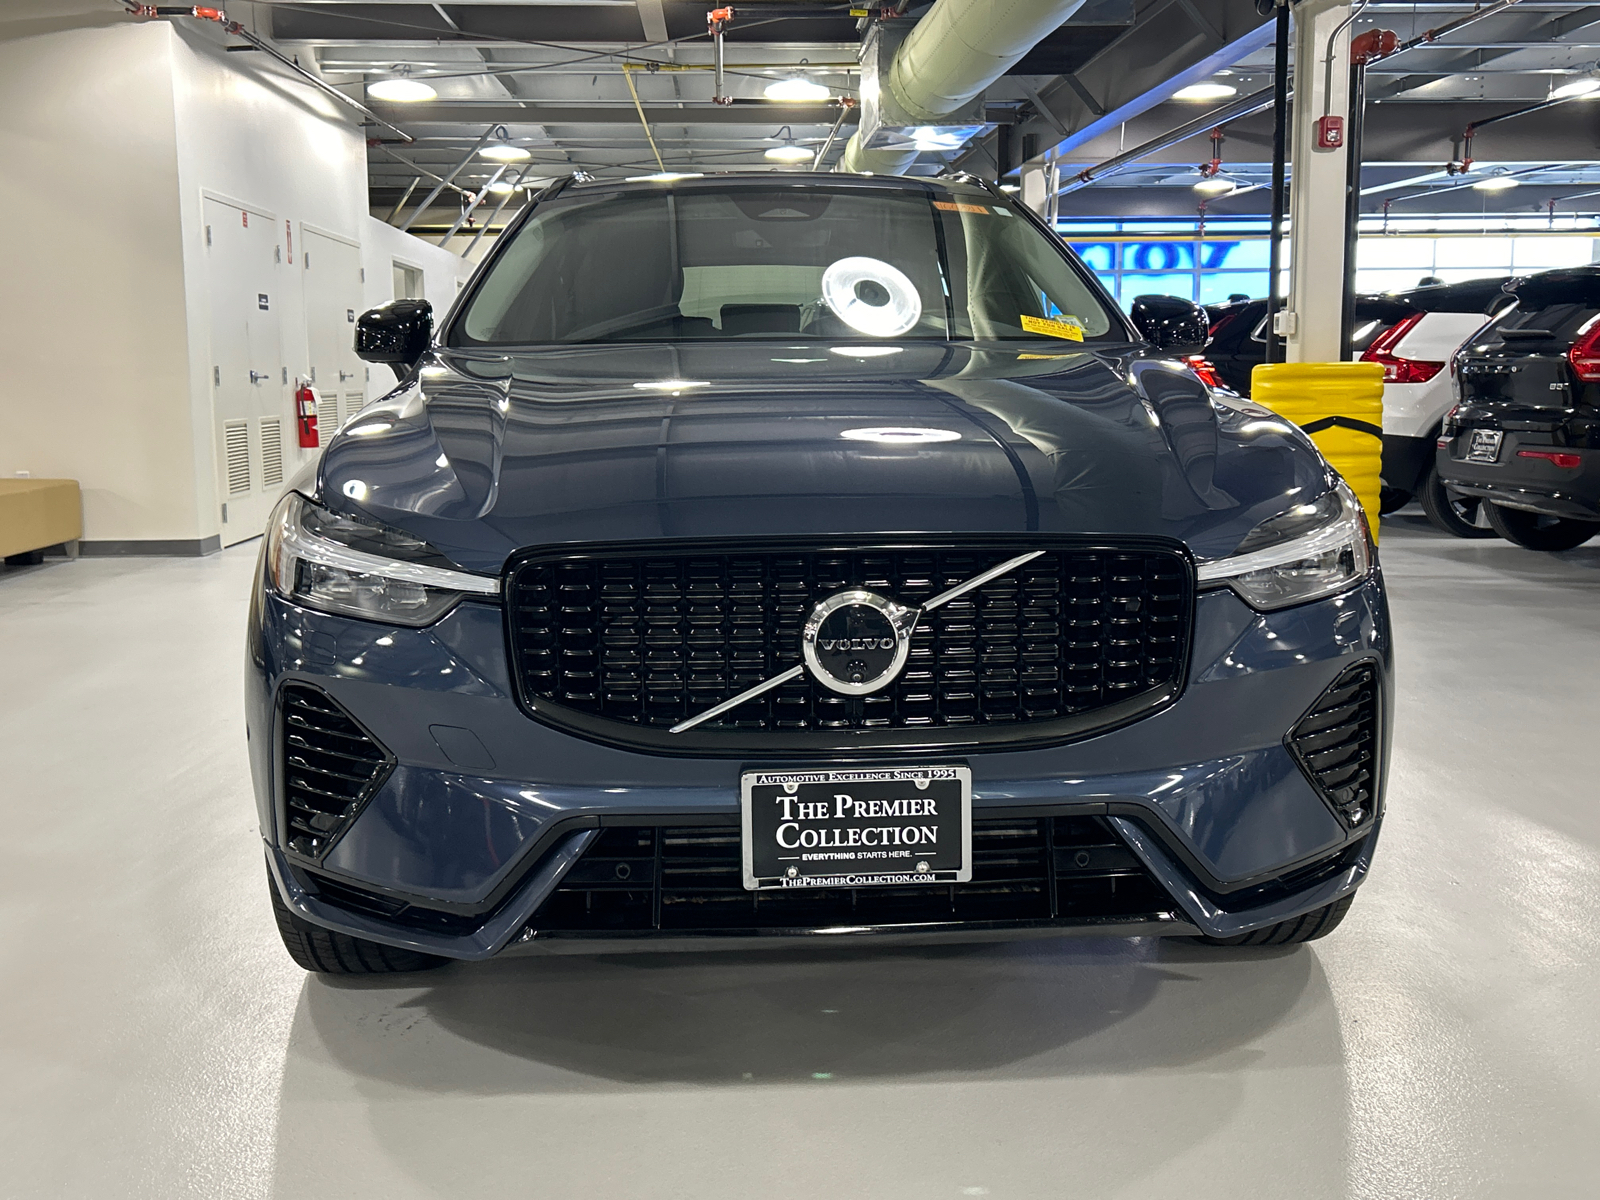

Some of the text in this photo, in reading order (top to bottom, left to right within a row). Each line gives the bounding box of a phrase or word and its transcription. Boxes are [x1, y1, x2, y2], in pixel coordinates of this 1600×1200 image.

[819, 638, 894, 650] VOLVO
[759, 769, 955, 784] AUTOMOTIVE EXCELLENCE SINCE 1995
[775, 794, 938, 820] THE PREMIER
[776, 822, 938, 848] COLLECTION
[802, 850, 912, 861] EVERYTHING STARTS HERE.
